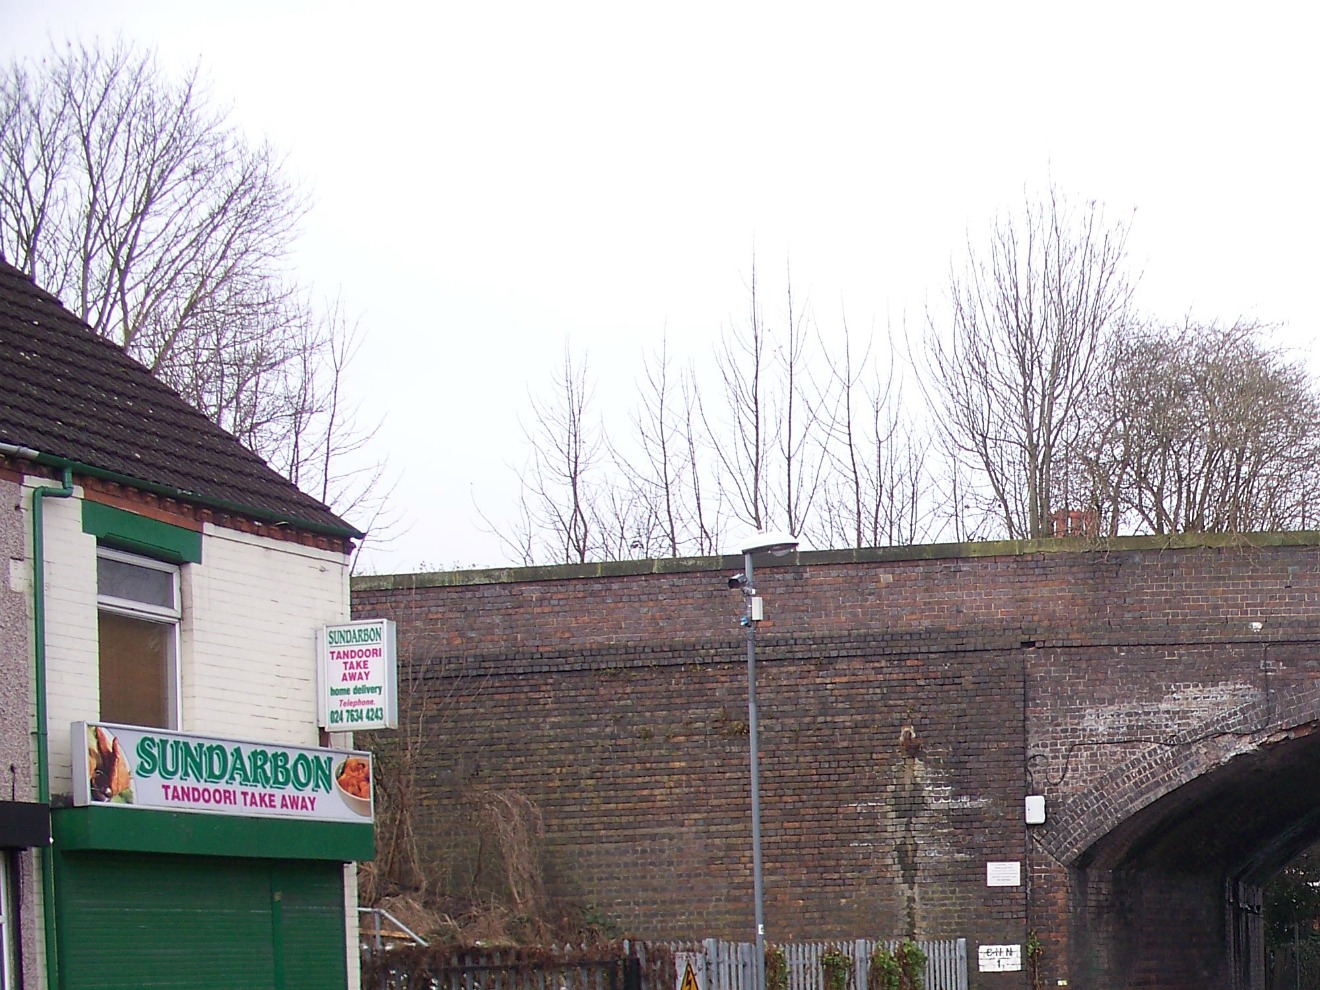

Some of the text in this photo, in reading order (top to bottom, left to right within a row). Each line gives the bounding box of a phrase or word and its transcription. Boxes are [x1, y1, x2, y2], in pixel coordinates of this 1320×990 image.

[328, 627, 382, 645] SUNDARBON
[329, 648, 382, 661] TANDOORI
[343, 660, 369, 671] TAKE
[341, 671, 371, 682] AWAY
[330, 685, 382, 697] home delivery
[330, 707, 383, 723] 024 7634 4243
[136, 736, 335, 793] SUNDARBON
[162, 784, 317, 811] TANDOORI TAKE AWAY
